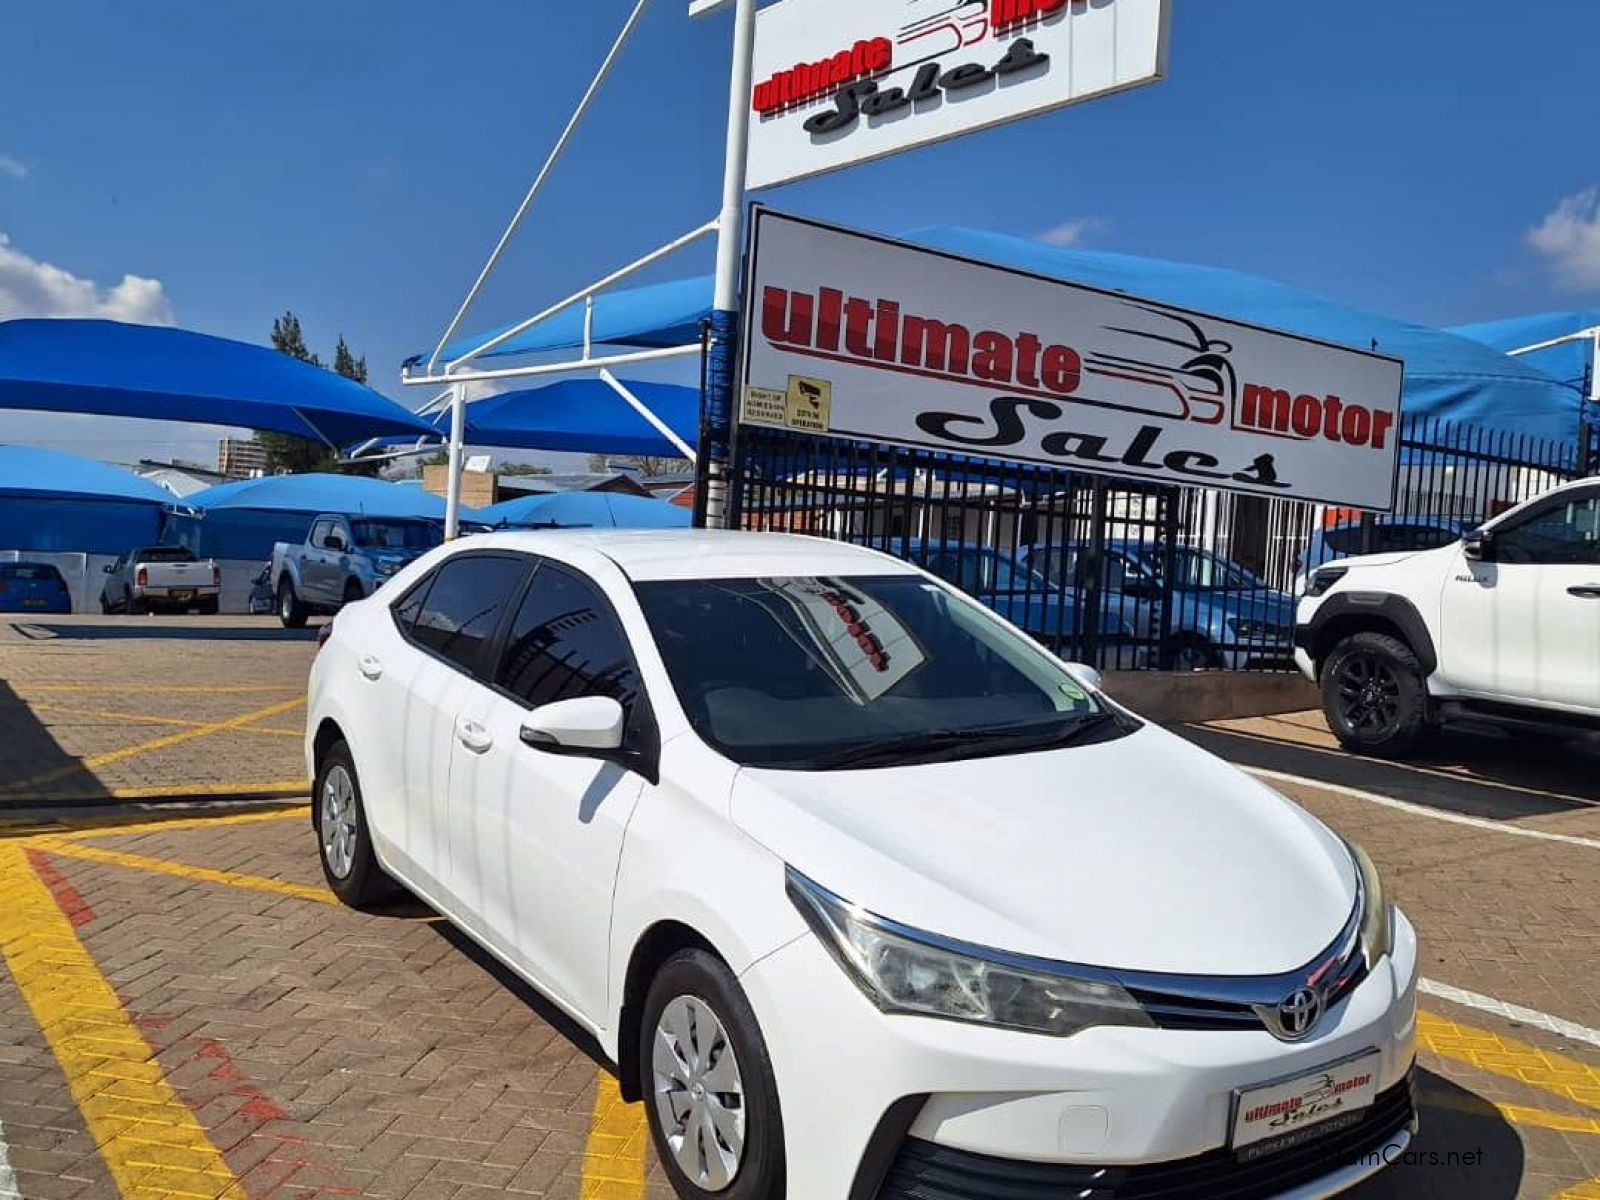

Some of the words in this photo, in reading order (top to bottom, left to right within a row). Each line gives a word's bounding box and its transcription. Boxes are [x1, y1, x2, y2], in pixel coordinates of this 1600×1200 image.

[752, 37, 893, 113] ultimate
[803, 38, 1050, 134] Sales
[762, 285, 1081, 393] ultimate
[1241, 380, 1393, 450] motor
[915, 396, 1291, 487] Sales
[1334, 1074, 1372, 1094] motor
